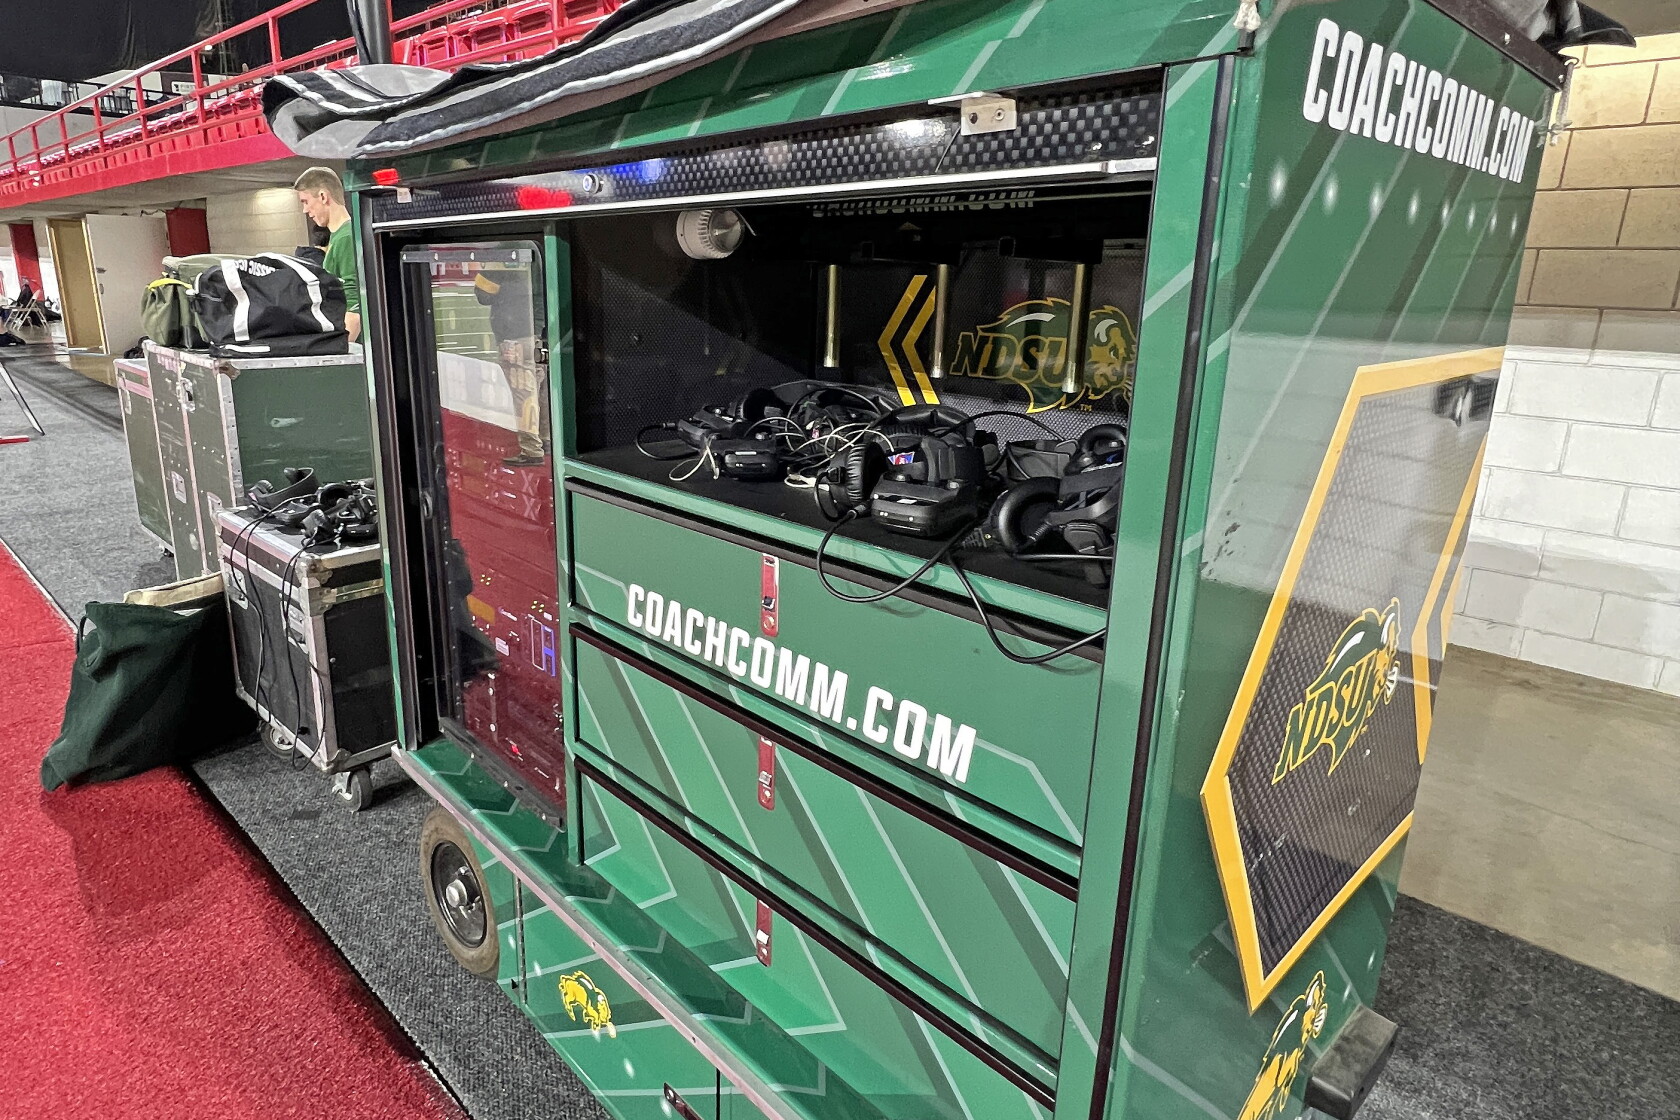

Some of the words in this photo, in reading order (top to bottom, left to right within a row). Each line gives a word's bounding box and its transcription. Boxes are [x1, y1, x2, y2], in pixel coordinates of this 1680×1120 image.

[1303, 18, 1534, 184] COACHCOMM.COM
[949, 331, 1071, 387] NDSU
[627, 583, 977, 784] COACHCOMM.COM
[1272, 648, 1378, 786] NDSU
